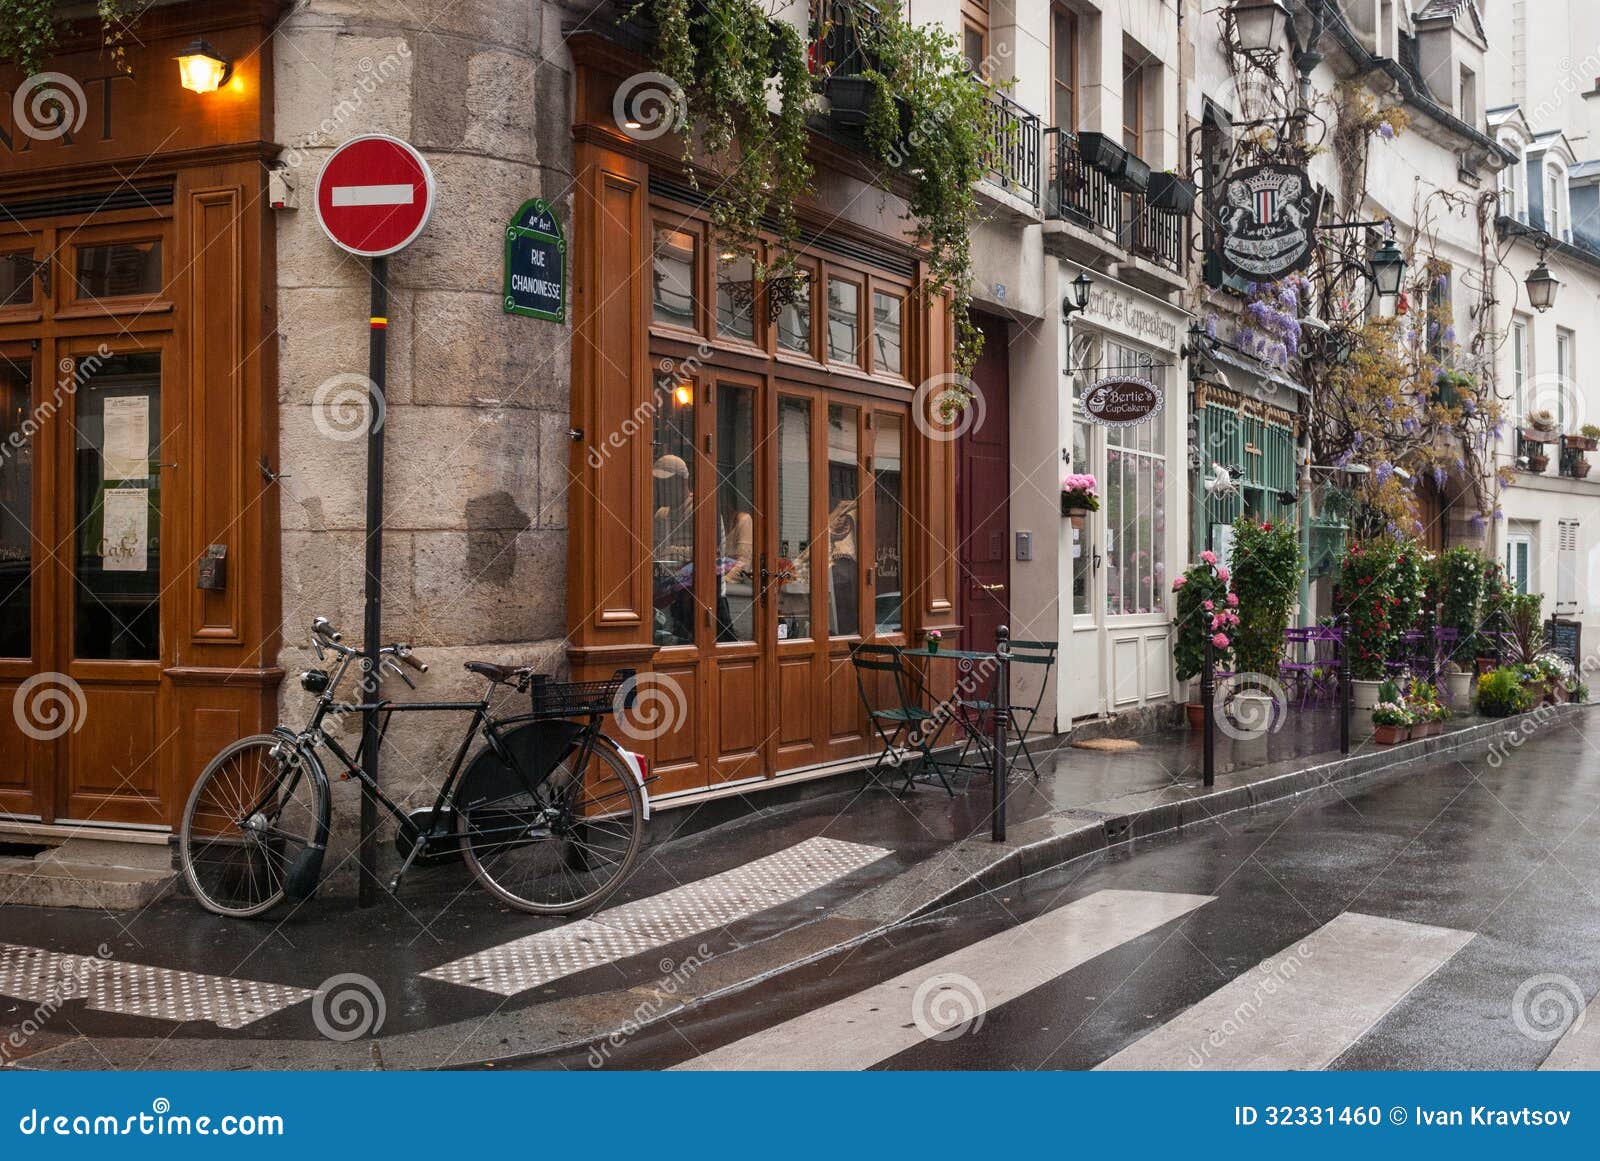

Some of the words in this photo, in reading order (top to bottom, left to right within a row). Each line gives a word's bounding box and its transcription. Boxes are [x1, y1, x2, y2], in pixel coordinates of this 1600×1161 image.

[531, 248, 545, 267] RUE
[511, 274, 561, 300] CHANOINESSE
[1110, 391, 1153, 404] Bertie's
